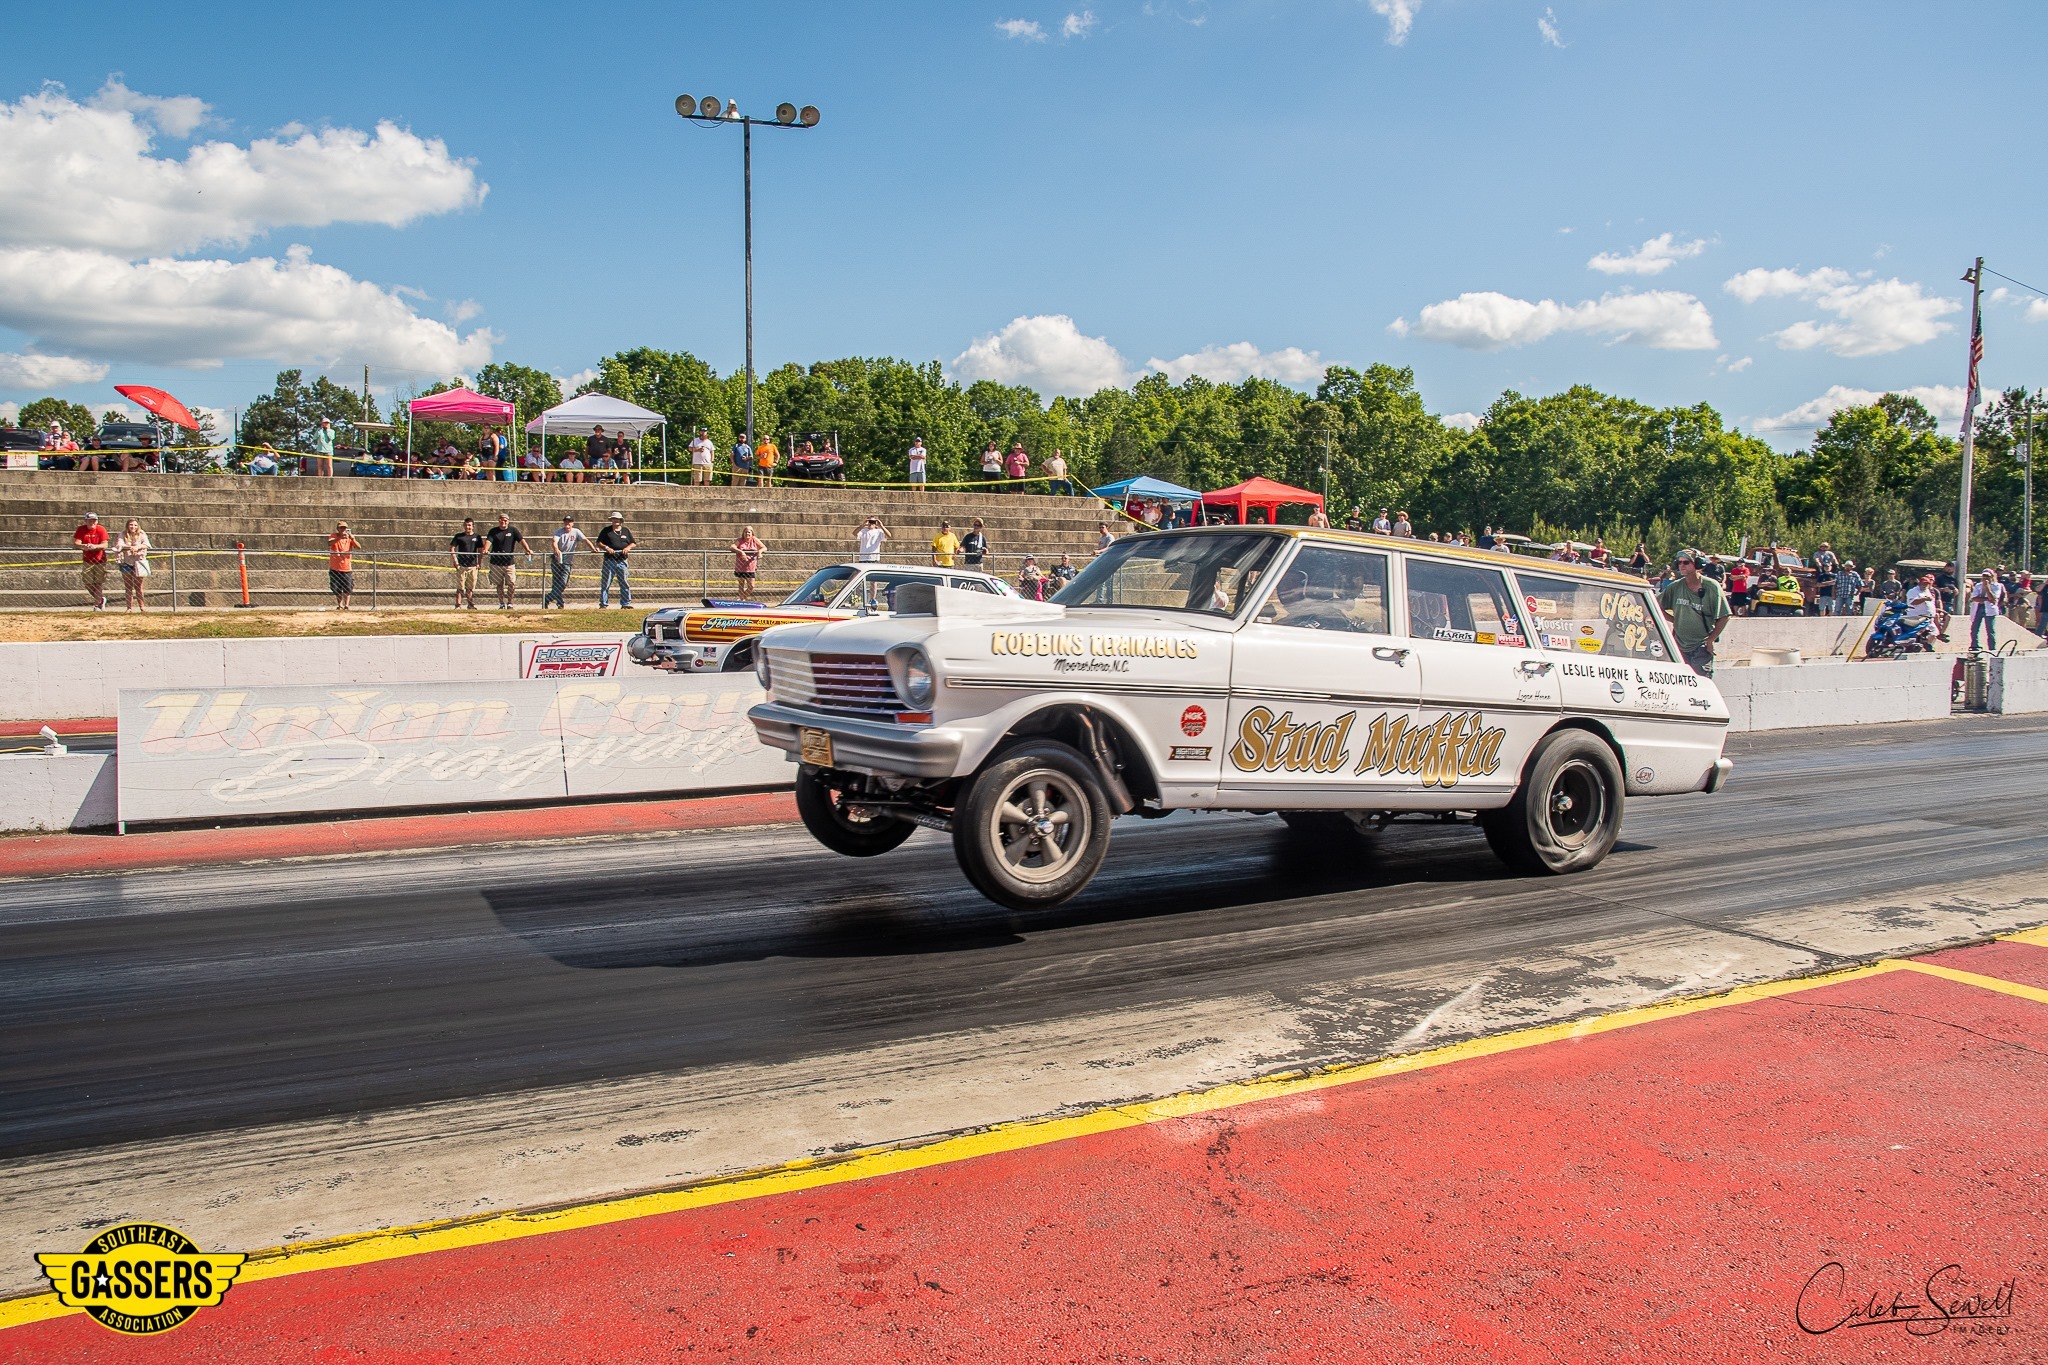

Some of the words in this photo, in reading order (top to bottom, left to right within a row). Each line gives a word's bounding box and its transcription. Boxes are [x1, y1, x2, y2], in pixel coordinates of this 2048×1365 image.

[1535, 616, 1574, 631] Hoosier
[991, 632, 1083, 657] ROBBINS
[1090, 634, 1198, 659] REPAIRABLES
[1551, 637, 1568, 647] RAM
[1624, 624, 1647, 651] 62
[537, 648, 618, 659] HICKORY
[538, 662, 608, 671] RPM
[1562, 664, 1595, 678] LESLIE
[1598, 666, 1629, 681] HORNE
[1635, 669, 1644, 683] &
[1649, 671, 1698, 688] ASSOCIATES
[1637, 686, 1670, 704] Realty
[139, 689, 515, 755] Union
[538, 682, 768, 739] Cou
[1184, 711, 1204, 720] NGK
[1228, 705, 1357, 774] Stud
[1353, 711, 1507, 788] Muffin
[210, 722, 760, 802] Dragway
